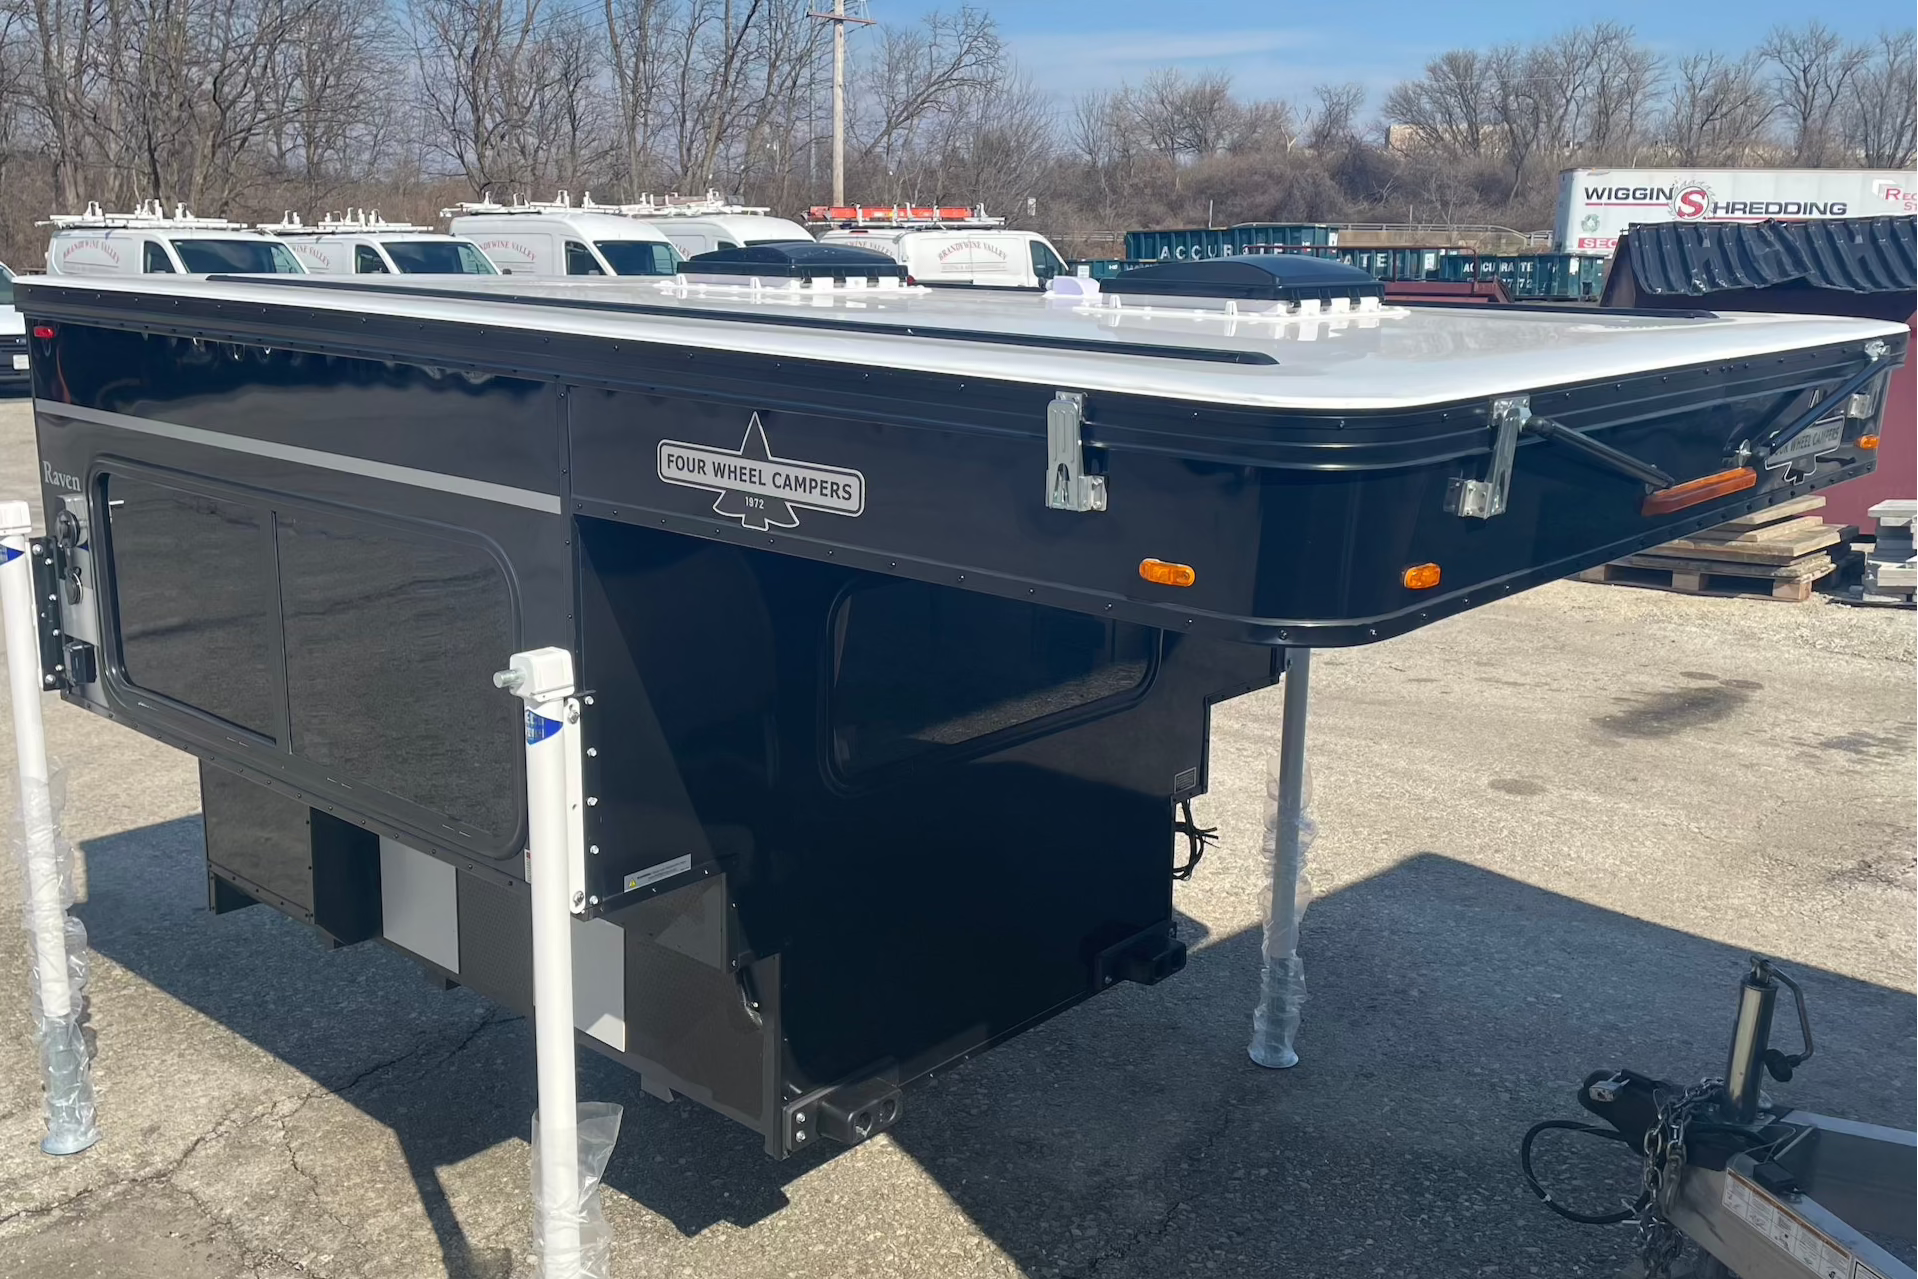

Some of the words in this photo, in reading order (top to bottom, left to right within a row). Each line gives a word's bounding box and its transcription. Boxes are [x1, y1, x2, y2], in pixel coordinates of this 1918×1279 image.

[43, 460, 81, 492] Raven
[667, 453, 707, 476] FOUR
[712, 461, 766, 486] WHEEL
[772, 471, 853, 501] CAMPERS
[745, 496, 765, 509] 1972
